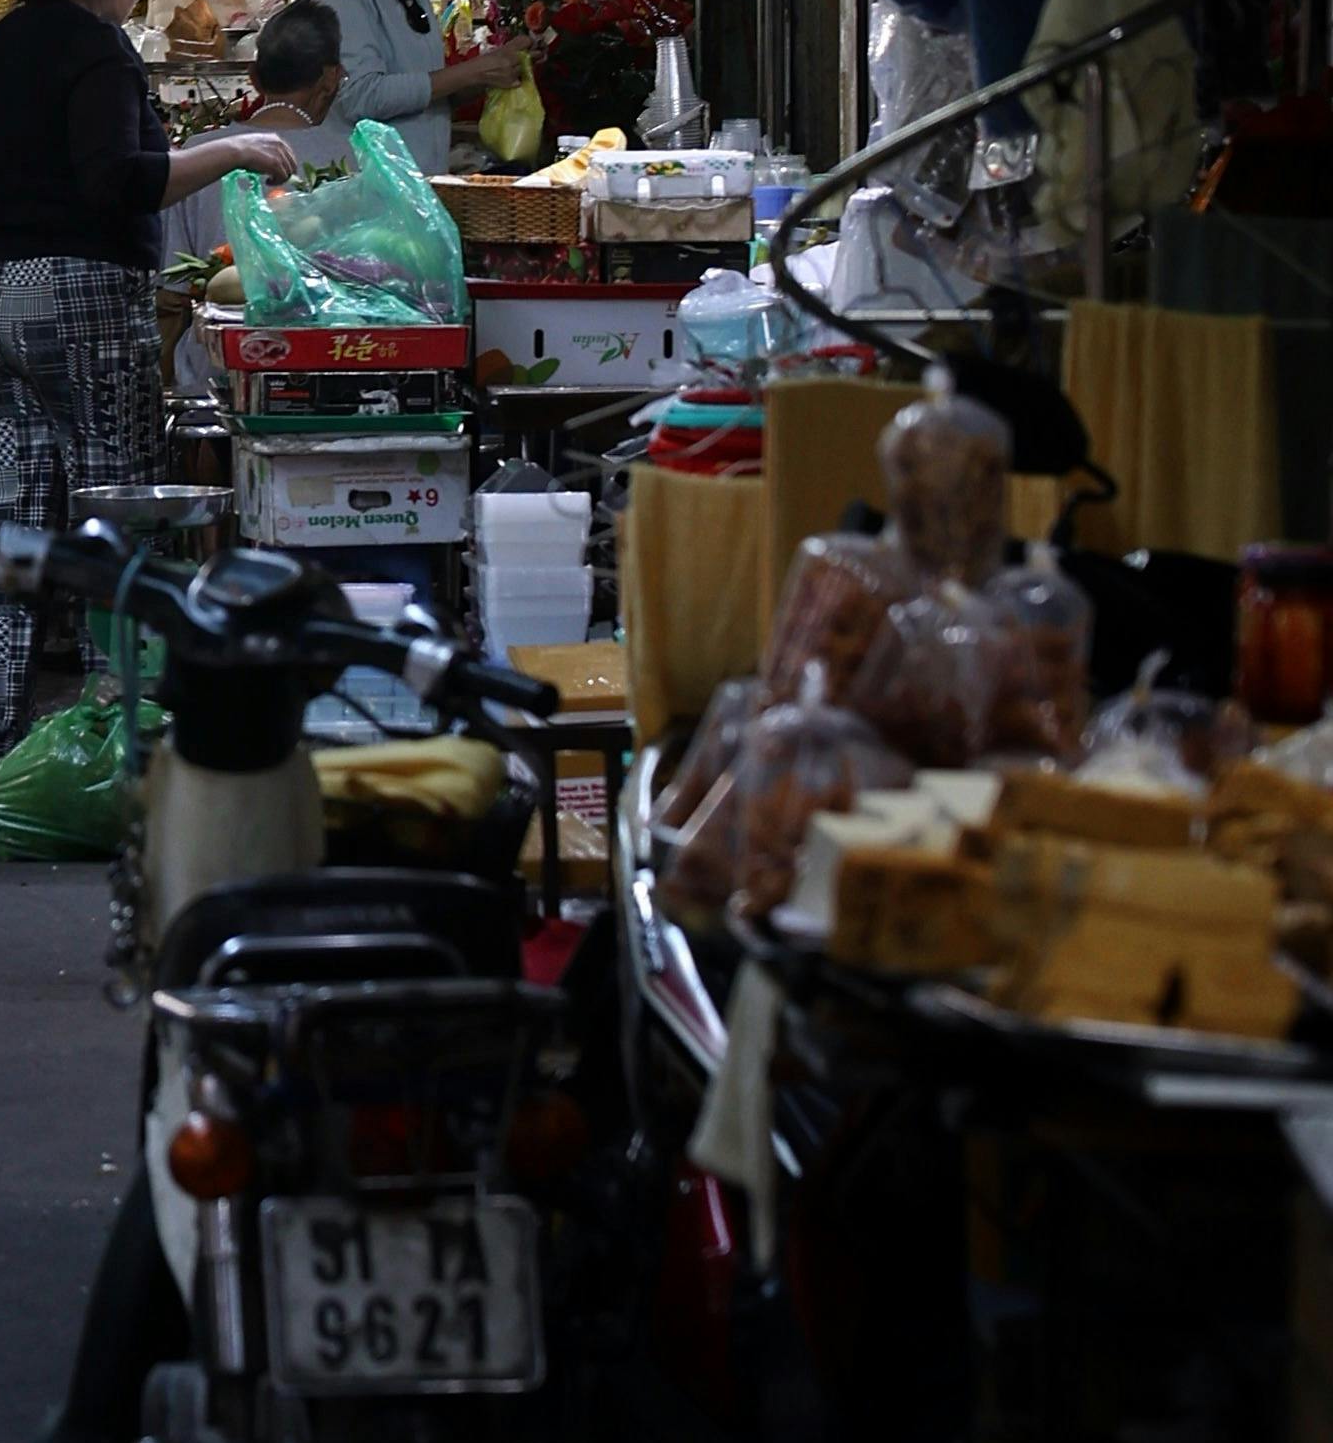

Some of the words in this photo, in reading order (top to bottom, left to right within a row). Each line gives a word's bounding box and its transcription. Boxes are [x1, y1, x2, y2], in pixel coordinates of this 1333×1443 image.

[307, 513, 362, 530] Melon
[363, 511, 420, 528] Queen
[314, 1295, 487, 1368] 9621
